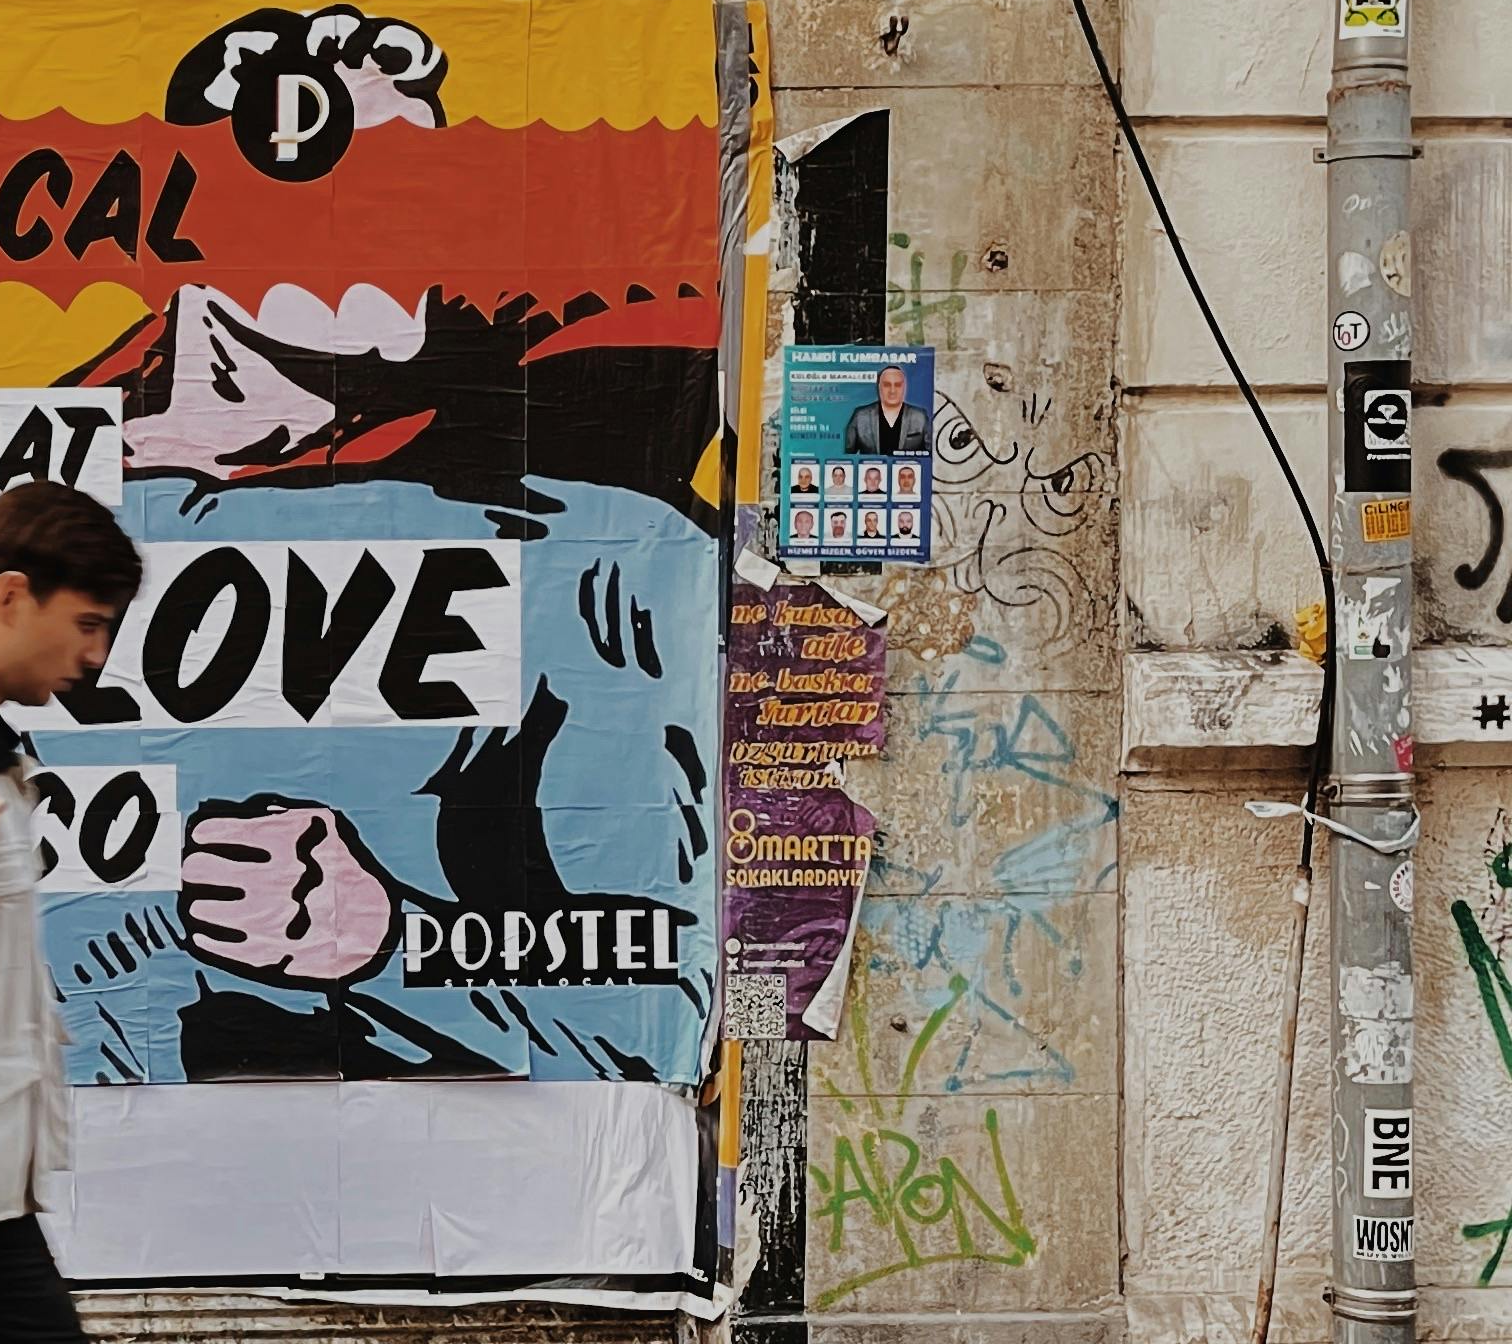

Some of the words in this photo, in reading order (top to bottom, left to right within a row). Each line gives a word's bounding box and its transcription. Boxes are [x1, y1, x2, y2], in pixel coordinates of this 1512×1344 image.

[839, 353, 918, 364] KUMBASAR
[801, 631, 867, 663] aile
[726, 868, 866, 888] SOKAKLARDAYIZ
[403, 909, 678, 972] POPSTEL
[444, 978, 518, 987] STAY
[538, 977, 636, 987] LOCAL
[1372, 1117, 1409, 1189] BNE
